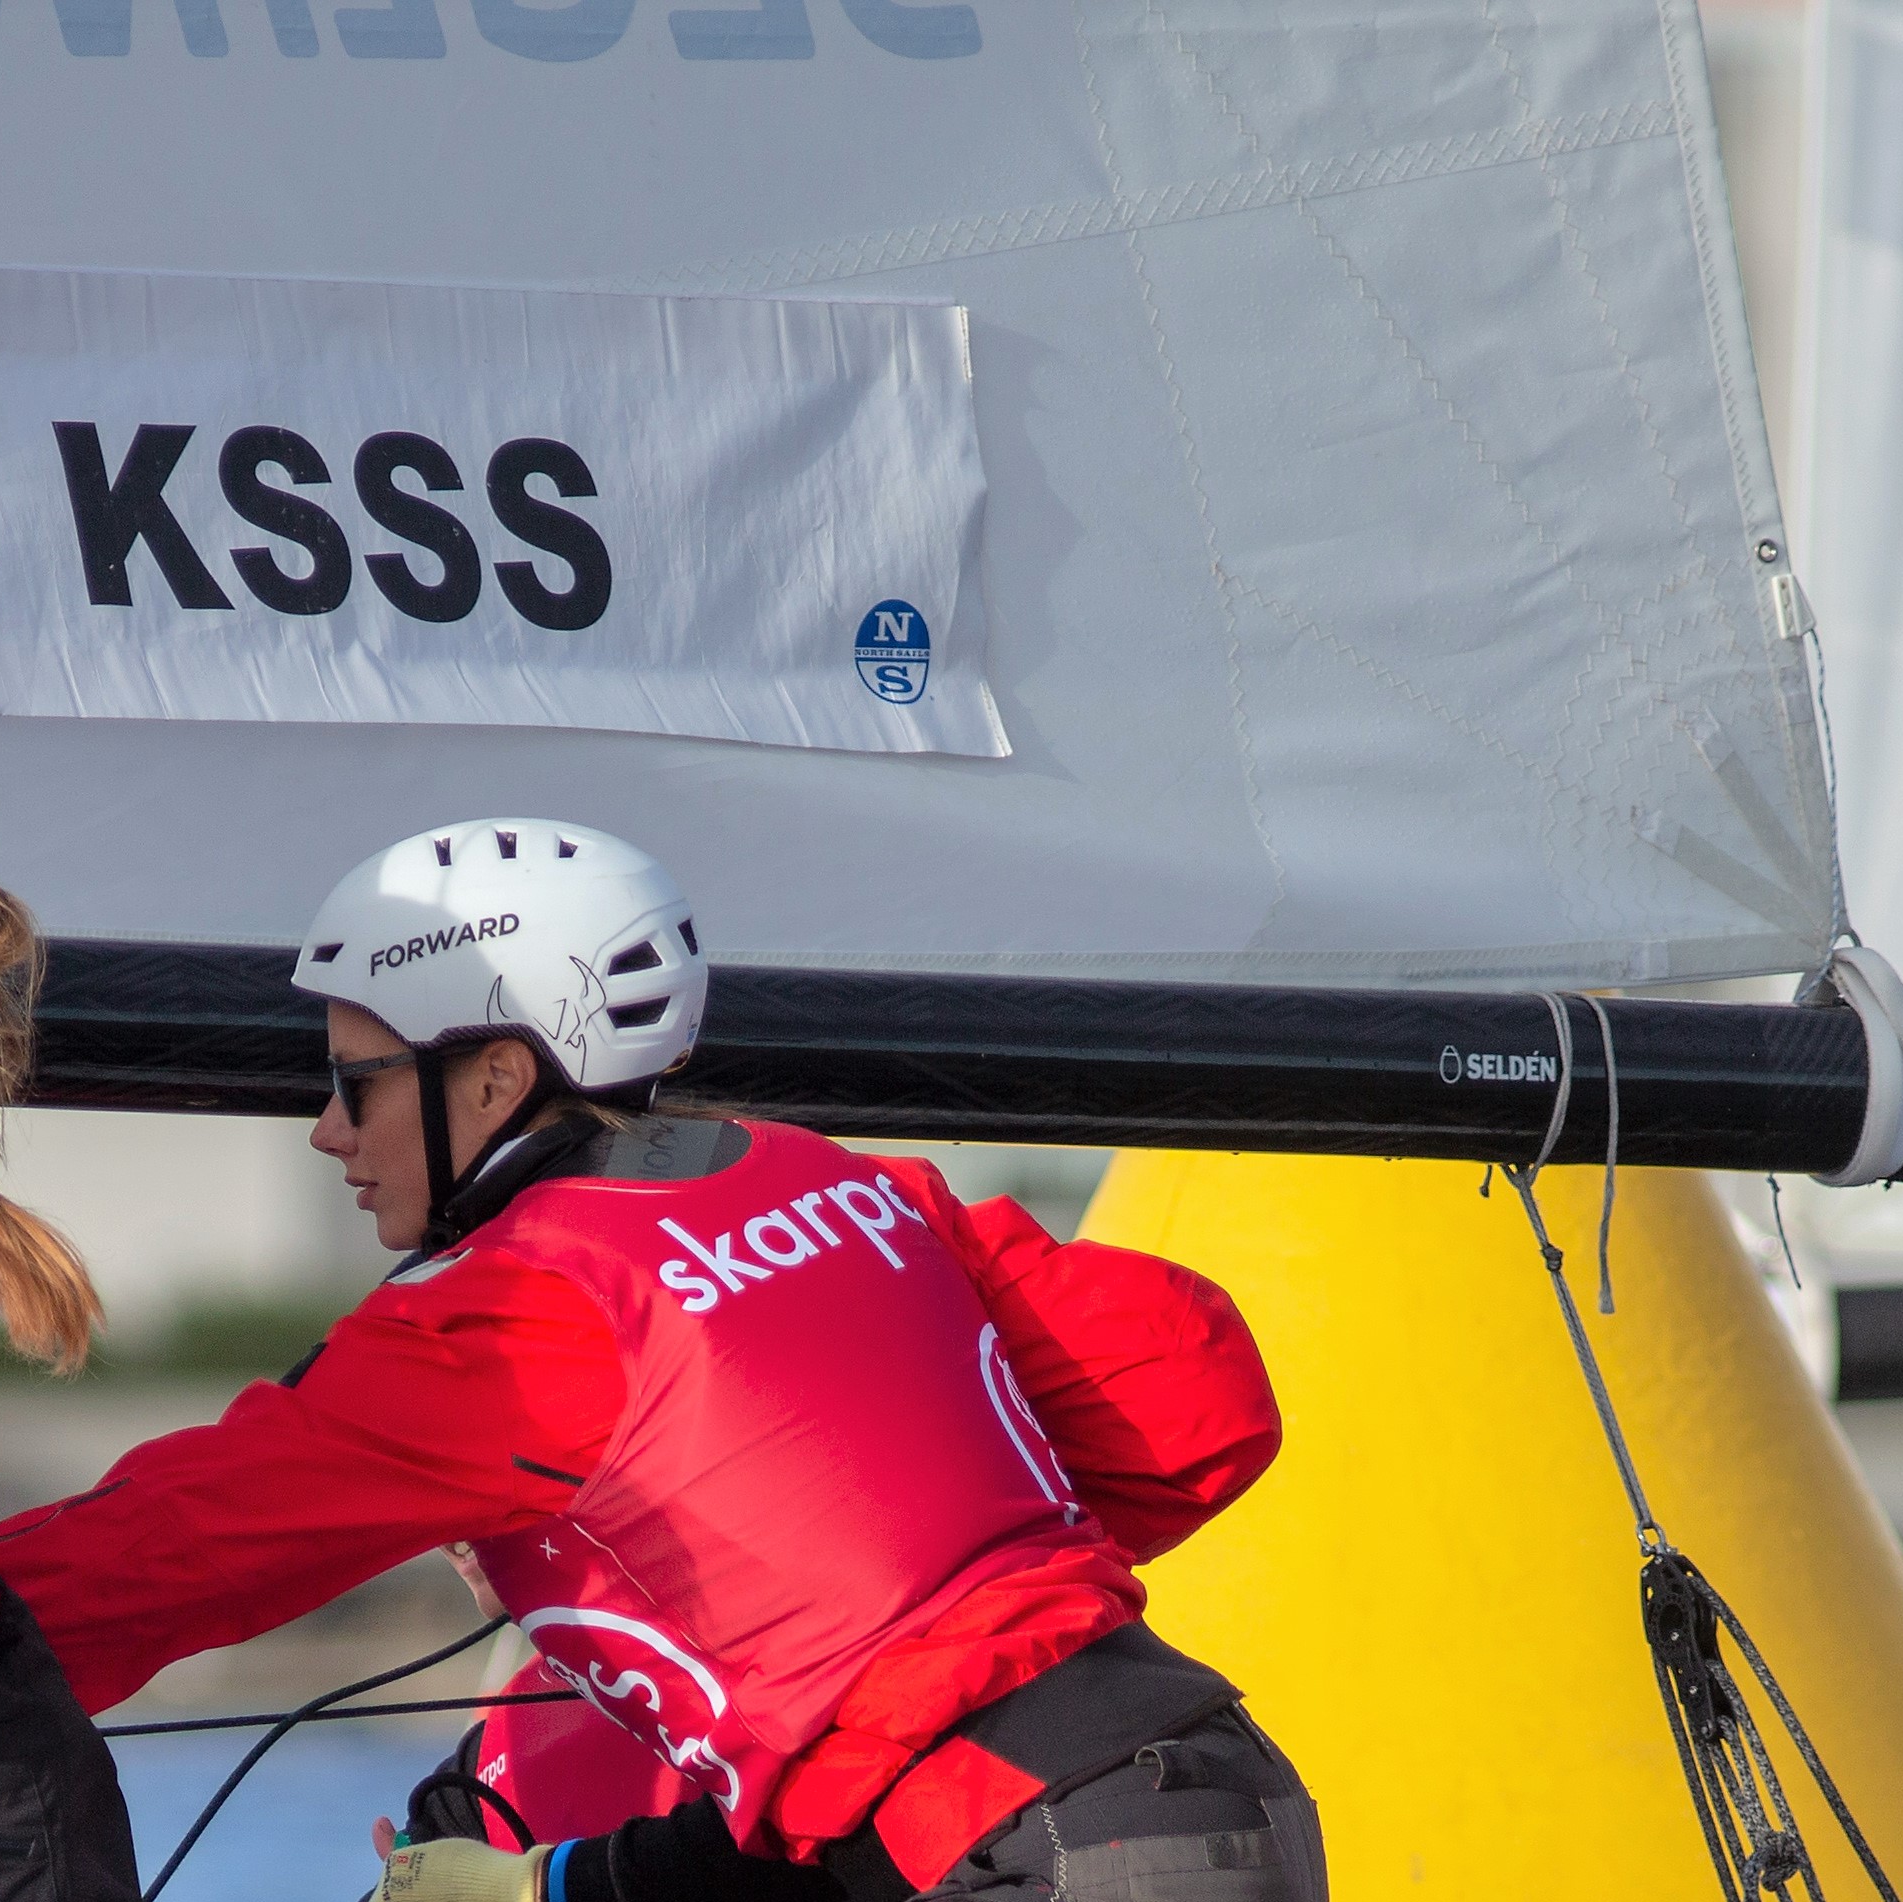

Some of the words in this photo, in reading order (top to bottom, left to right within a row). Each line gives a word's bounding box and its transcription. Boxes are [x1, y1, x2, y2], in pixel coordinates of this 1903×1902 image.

[50, 420, 614, 633] KSSS
[855, 648, 894, 657] NORTH
[896, 649, 930, 657] SAILS
[369, 913, 521, 977] FORWARD
[1466, 1050, 1557, 1082] SELDÉN
